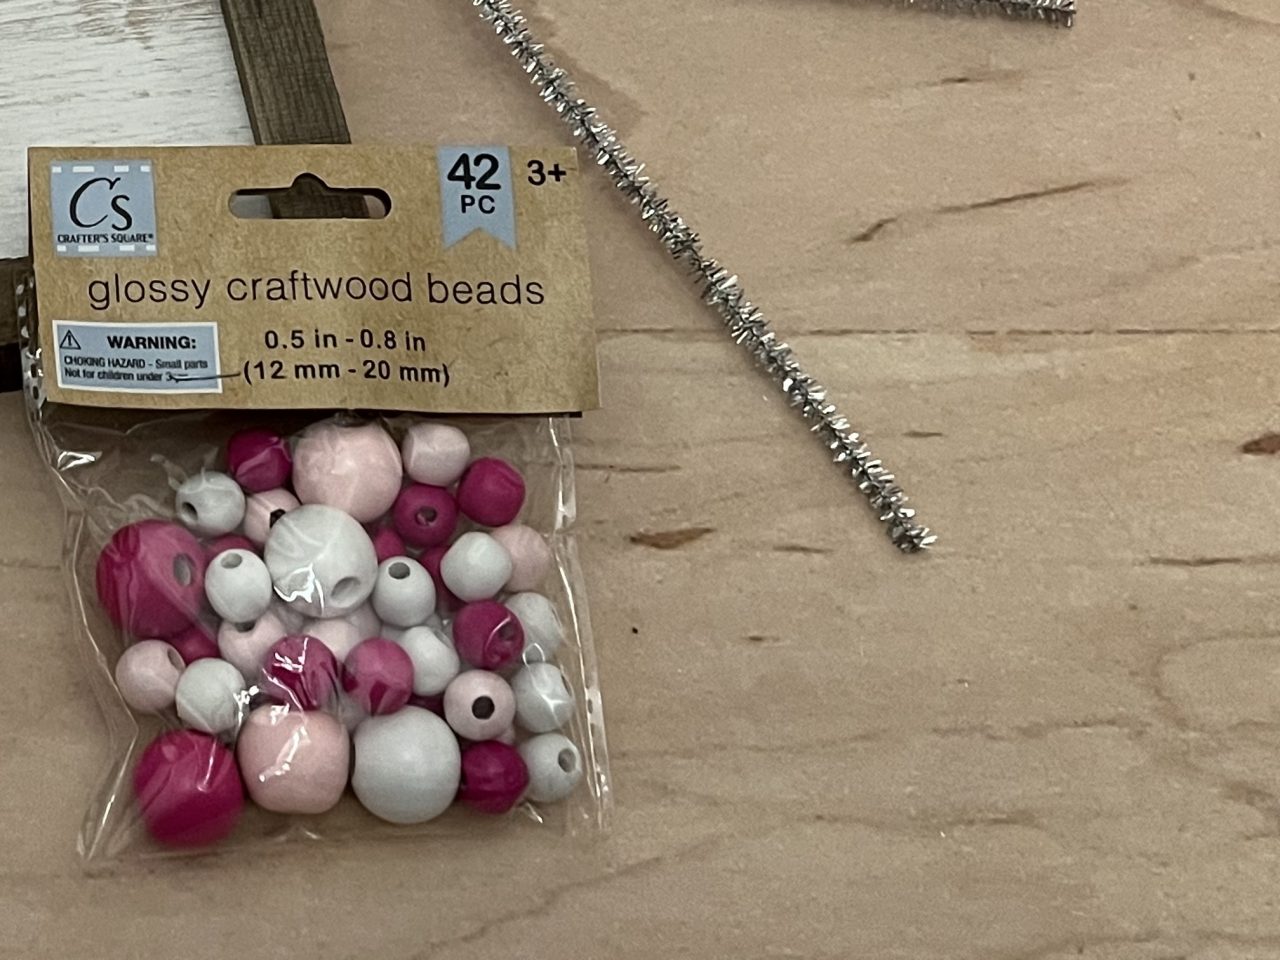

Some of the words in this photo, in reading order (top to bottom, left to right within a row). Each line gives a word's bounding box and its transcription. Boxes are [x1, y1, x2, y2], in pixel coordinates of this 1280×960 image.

[447, 153, 501, 190] 42
[527, 160, 567, 186] 3+
[461, 194, 495, 214] PC
[57, 234, 109, 244] CRAFTER'S
[88, 273, 211, 311] glossy
[227, 270, 413, 302] craftwood
[427, 272, 545, 305] beads
[107, 335, 197, 349] WARNING:
[264, 330, 305, 349] 0.5
[314, 329, 337, 348] in
[360, 329, 397, 349] 0.8
[405, 331, 426, 351] in
[64, 355, 105, 367] CHOKING
[107, 357, 145, 368] HAZARD
[155, 358, 182, 369] Small
[184, 359, 208, 371] parts
[64, 367, 80, 378] Not
[82, 368, 95, 379] for
[97, 368, 134, 380] children
[136, 370, 162, 381] under
[243, 360, 287, 385] (12
[294, 362, 340, 379] mm
[363, 360, 391, 380] 20
[399, 363, 450, 388] mm)
